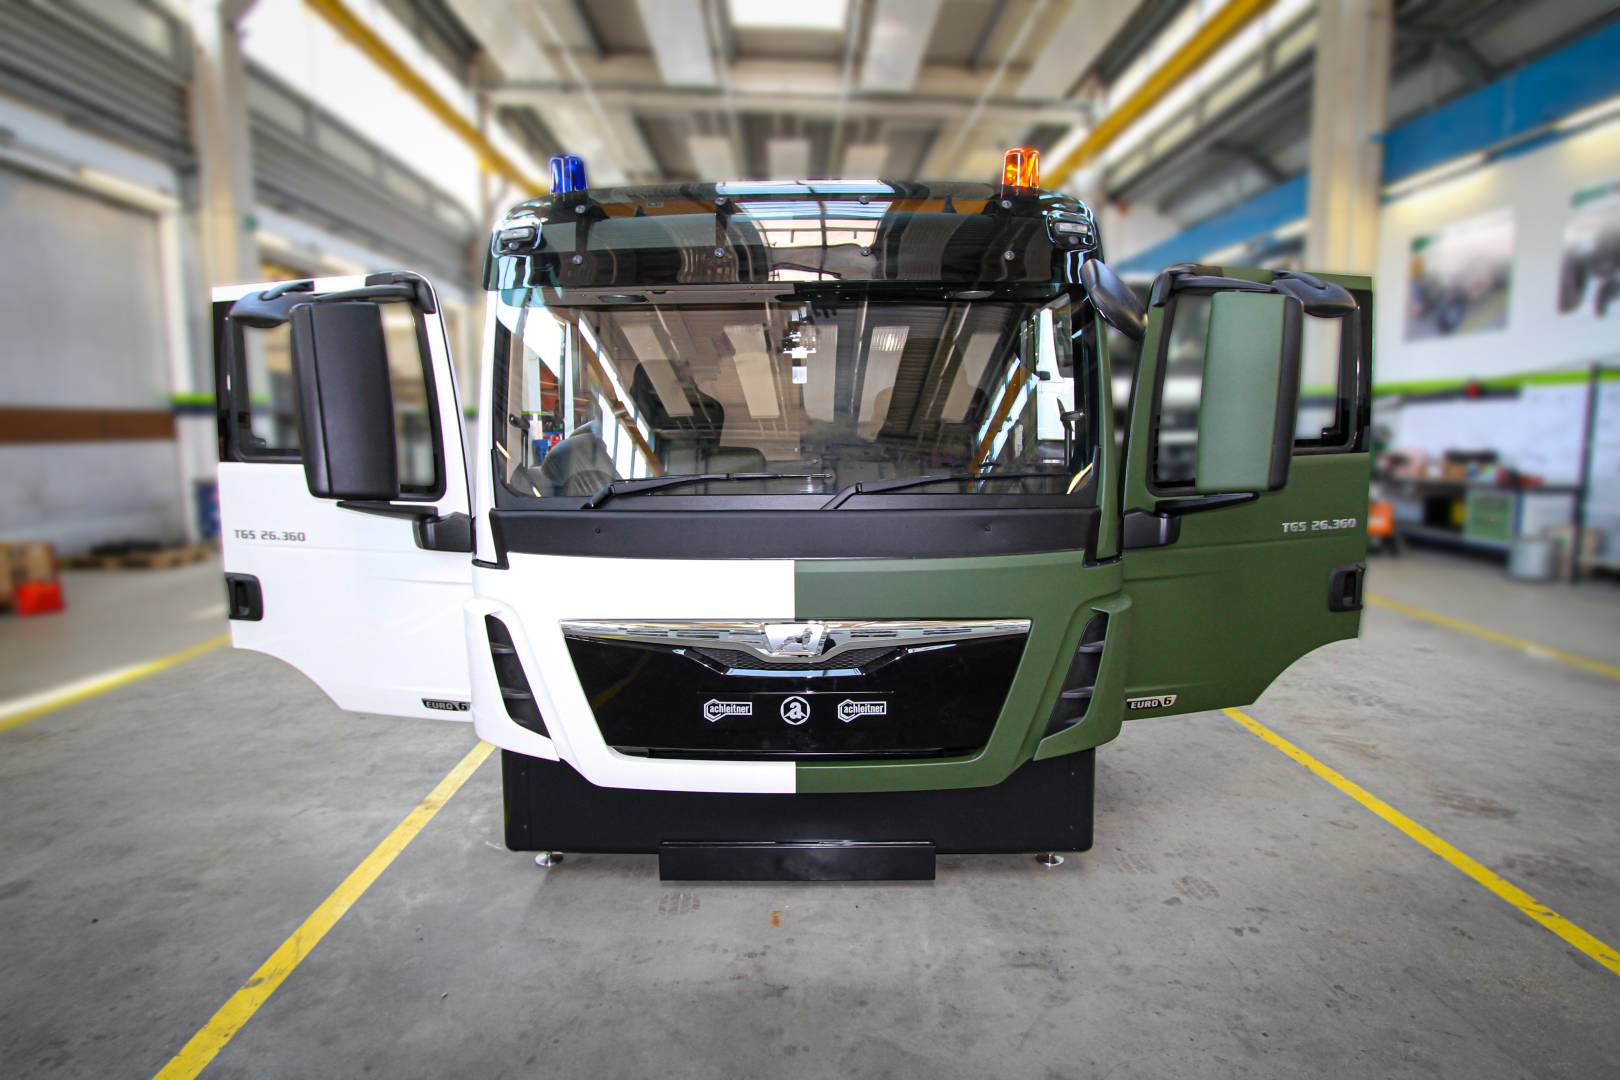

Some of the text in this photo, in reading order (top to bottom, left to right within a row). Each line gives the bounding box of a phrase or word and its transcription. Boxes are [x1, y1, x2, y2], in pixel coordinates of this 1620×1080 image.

[1281, 518, 1357, 533] TGS 26.360
[233, 529, 306, 542] TGS 26.360
[426, 701, 468, 711] EURO 6
[709, 703, 750, 714] achleitner
[843, 703, 884, 714] achleitner
[1130, 696, 1172, 709] EURO 6
